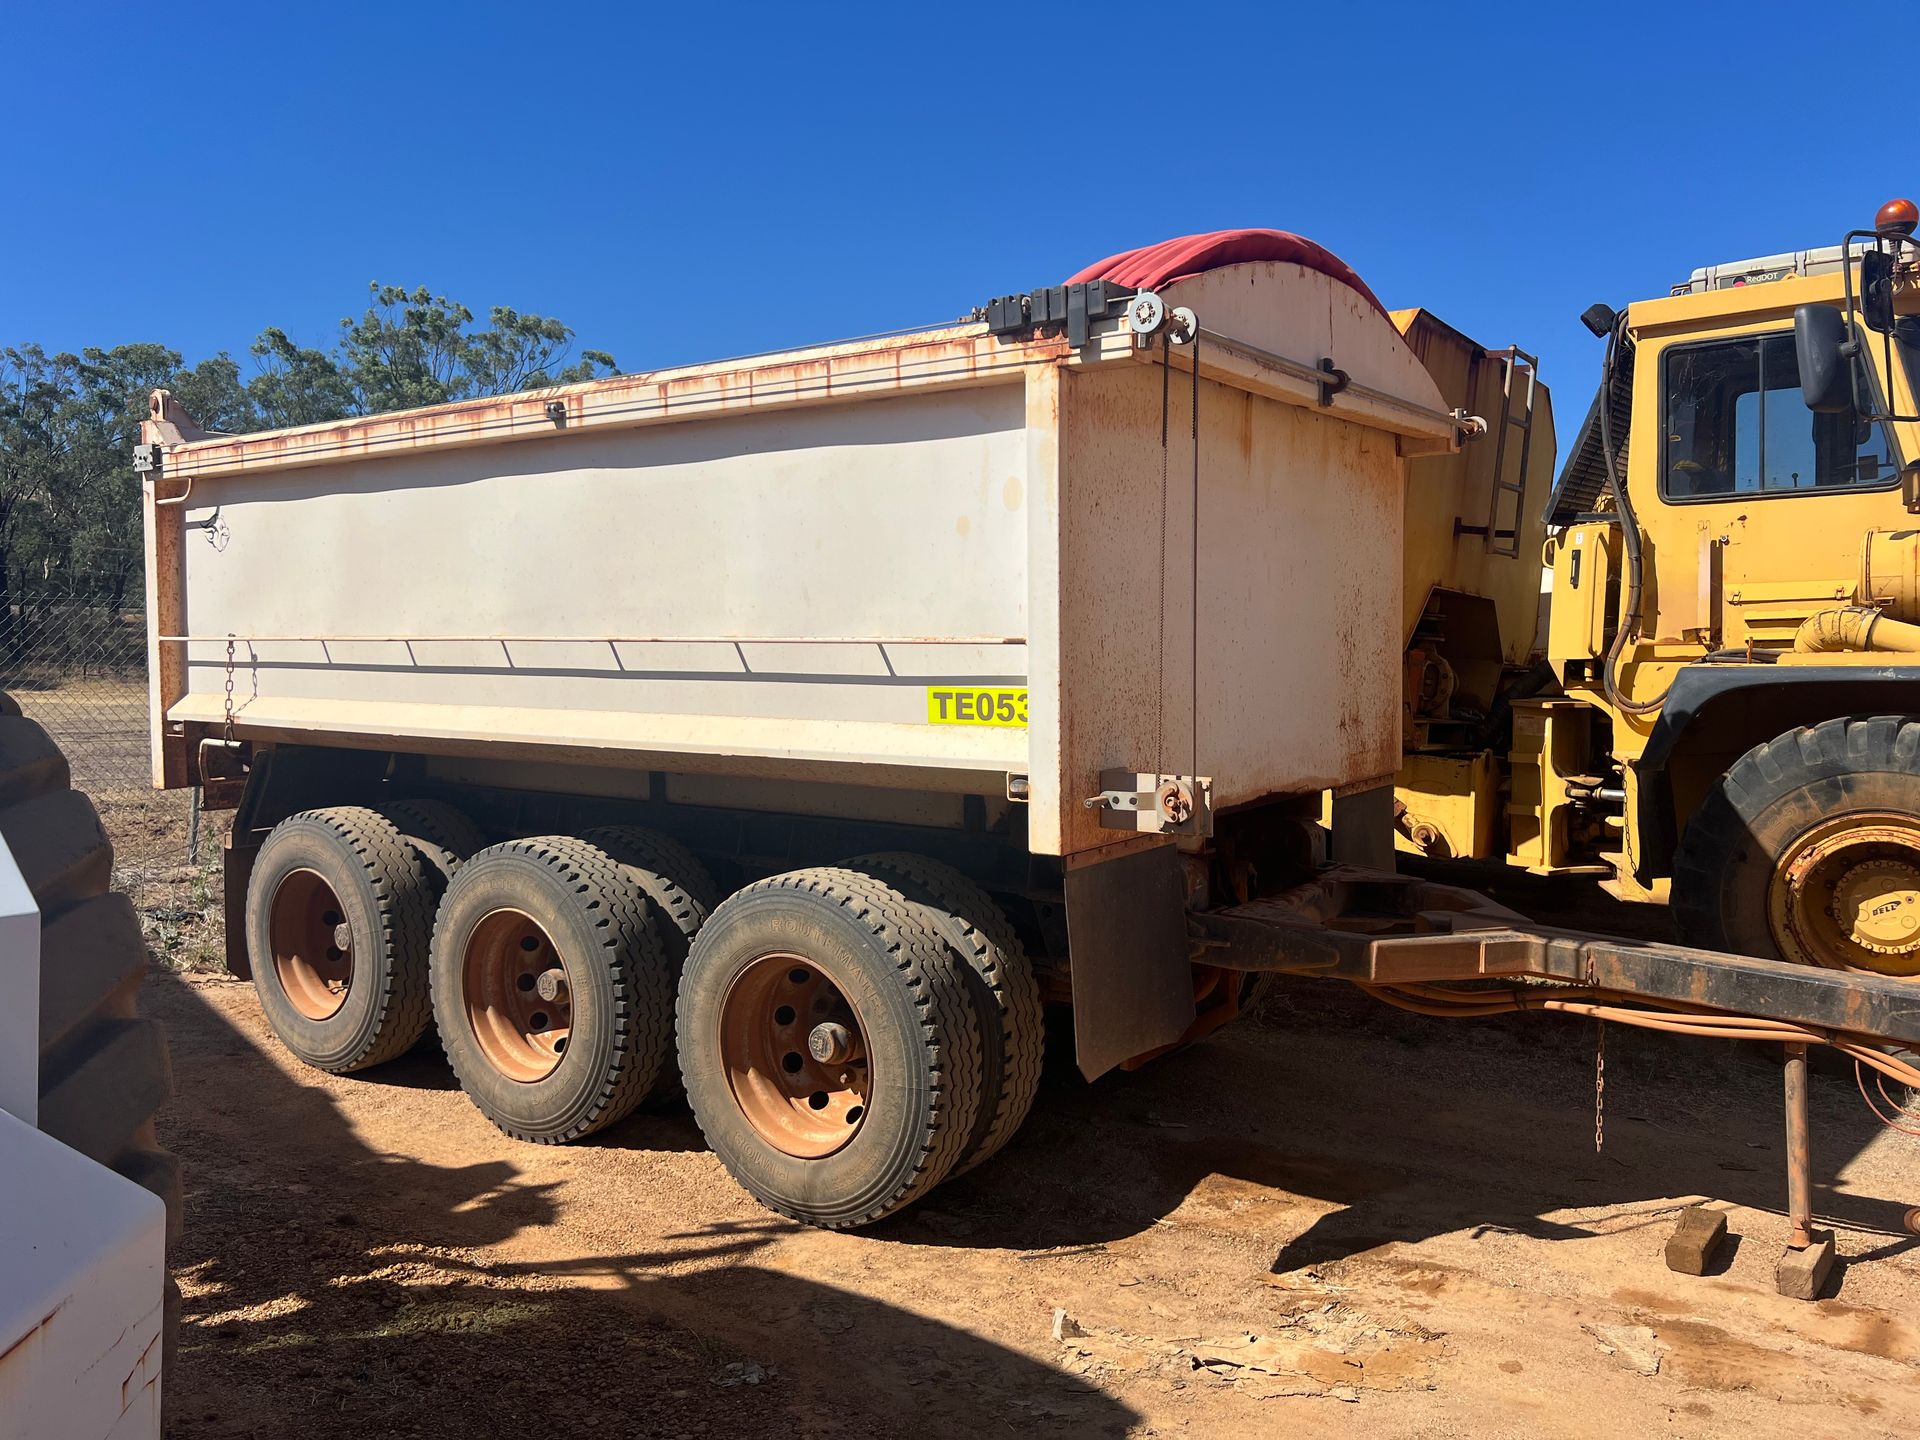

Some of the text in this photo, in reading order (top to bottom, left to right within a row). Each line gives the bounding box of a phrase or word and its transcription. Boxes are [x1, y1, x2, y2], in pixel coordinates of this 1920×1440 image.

[1746, 272, 1778, 283] RedDOT
[933, 692, 1028, 722] TE053
[1872, 904, 1897, 916] BELL
